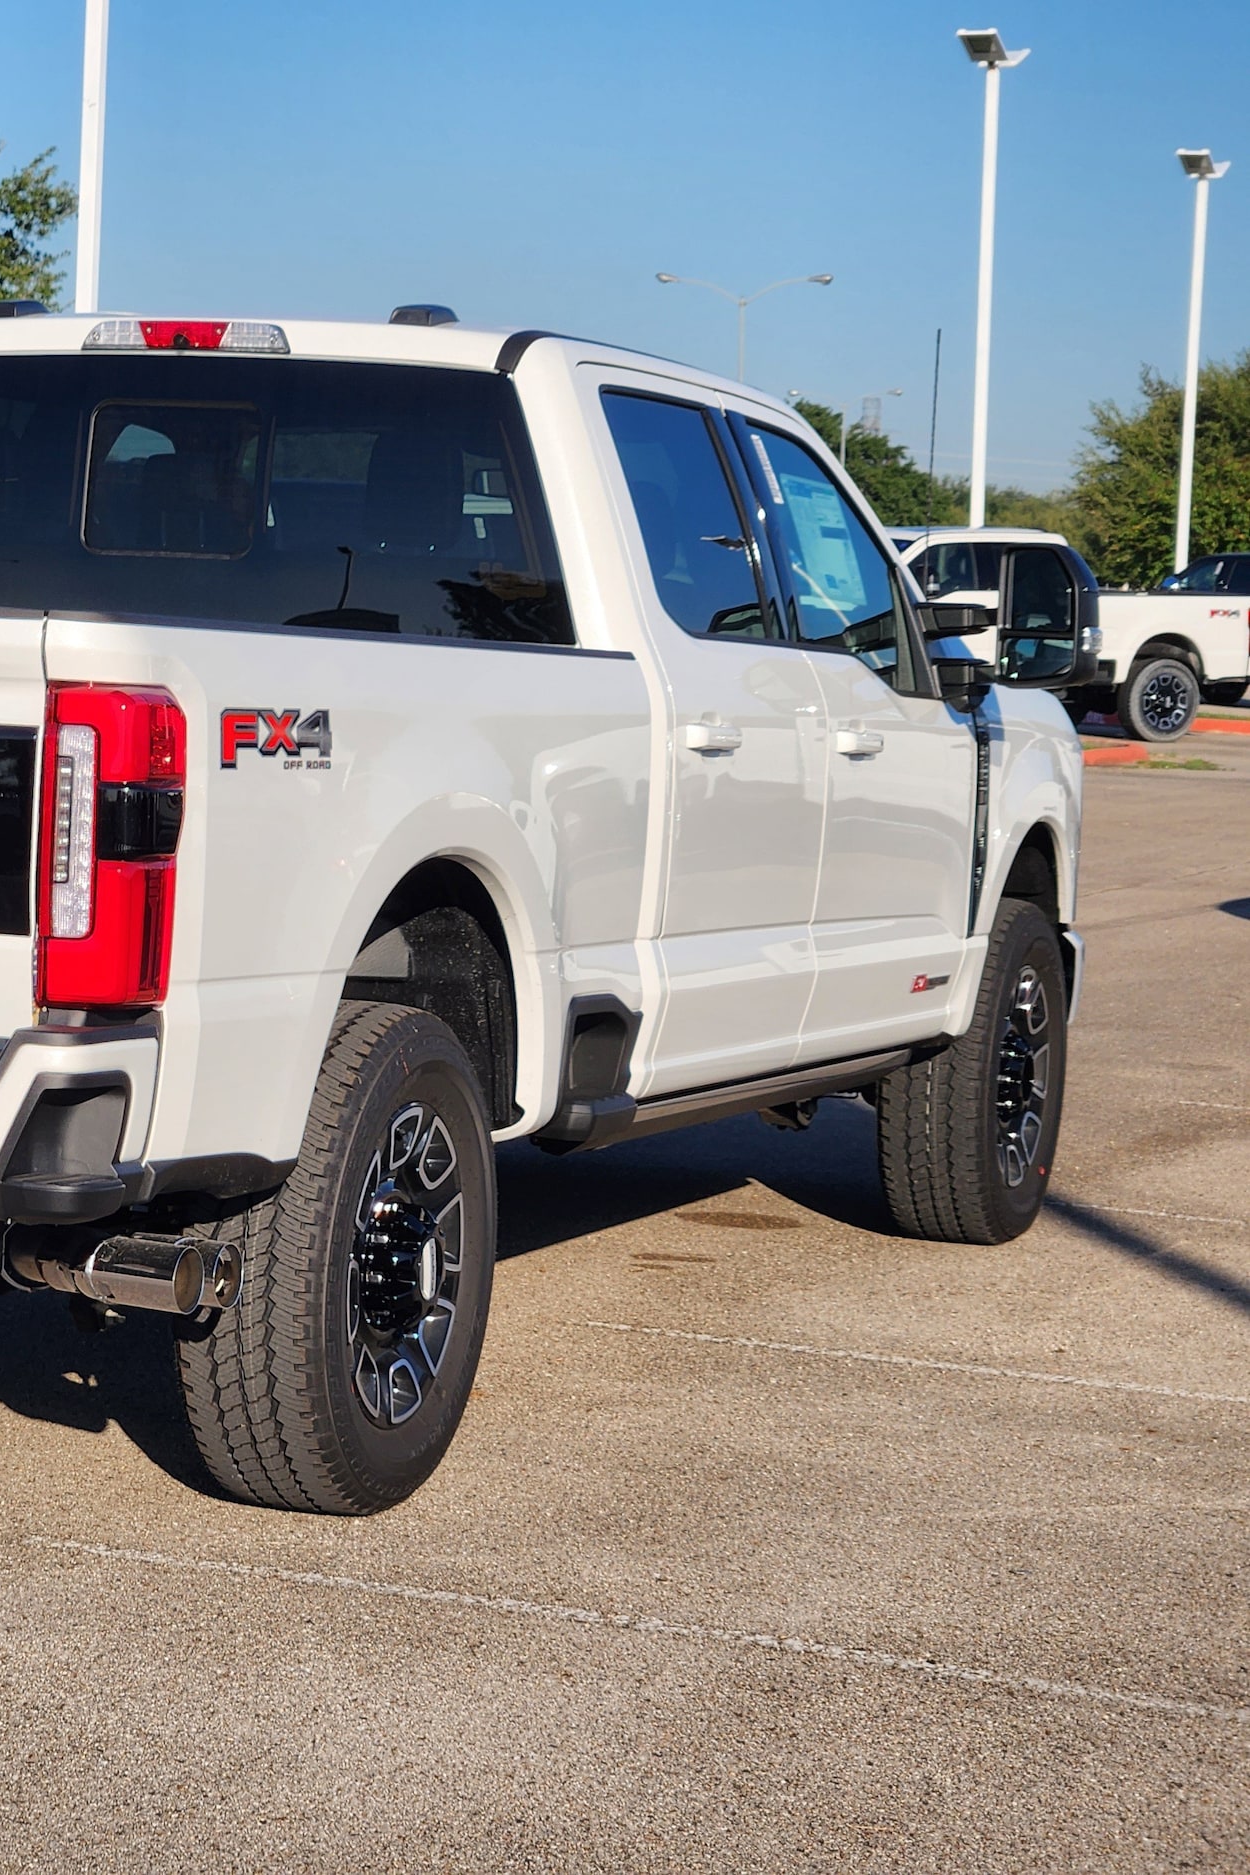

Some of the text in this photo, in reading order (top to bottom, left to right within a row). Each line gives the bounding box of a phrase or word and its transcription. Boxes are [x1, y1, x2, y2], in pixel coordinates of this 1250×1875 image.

[220, 707, 332, 769] FX4
[283, 760, 332, 770] OFF ROAD
